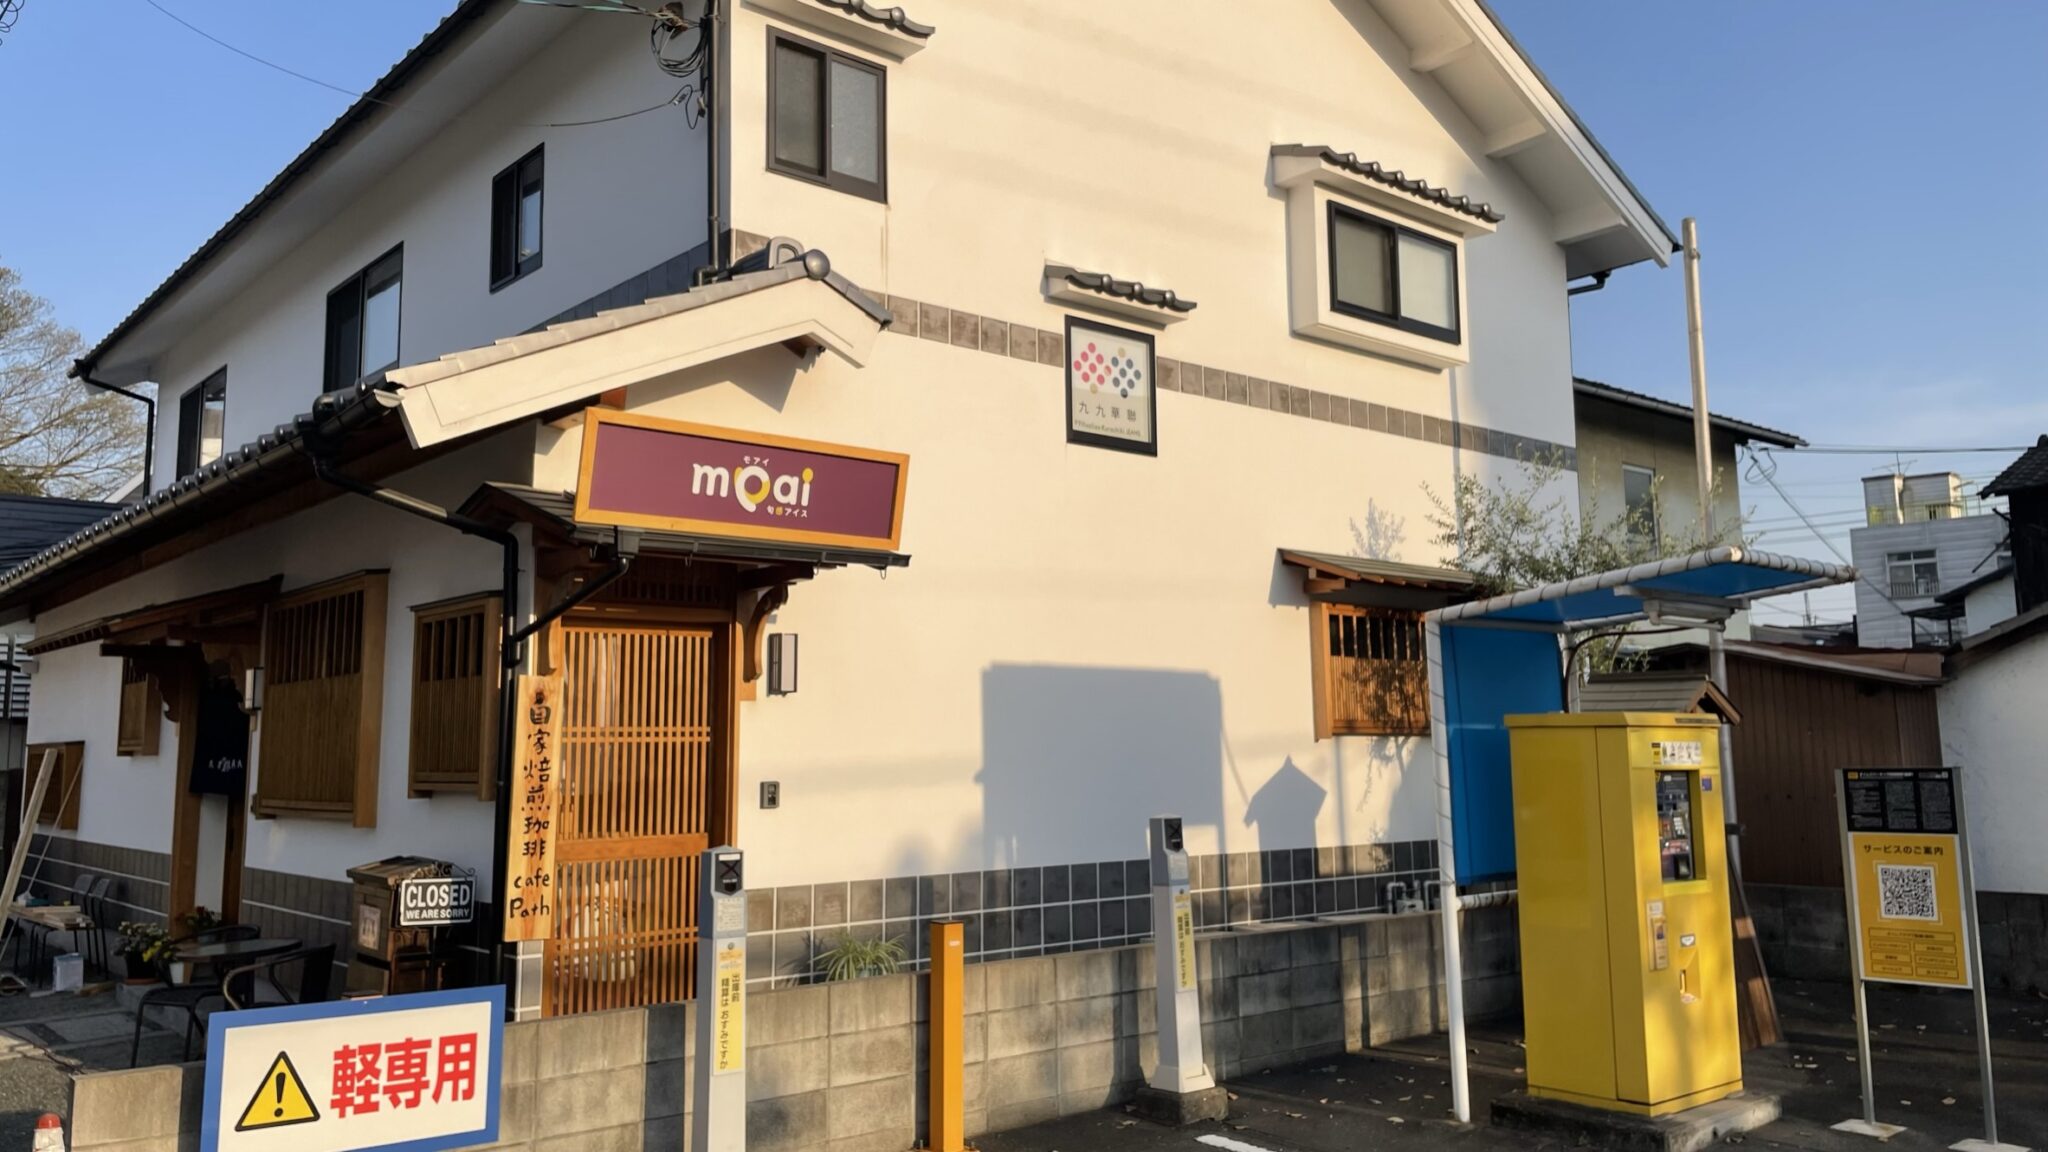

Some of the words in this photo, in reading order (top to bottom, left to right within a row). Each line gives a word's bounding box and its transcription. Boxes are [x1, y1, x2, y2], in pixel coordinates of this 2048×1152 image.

[743, 455, 770, 467] モアイ
[691, 463, 815, 513] moai
[406, 884, 471, 909] CLOSED
[510, 894, 551, 919] Path
[405, 909, 421, 920] WE
[421, 909, 440, 919] ARE
[440, 908, 470, 919] SORRY
[330, 1032, 478, 1119] 軽専用
